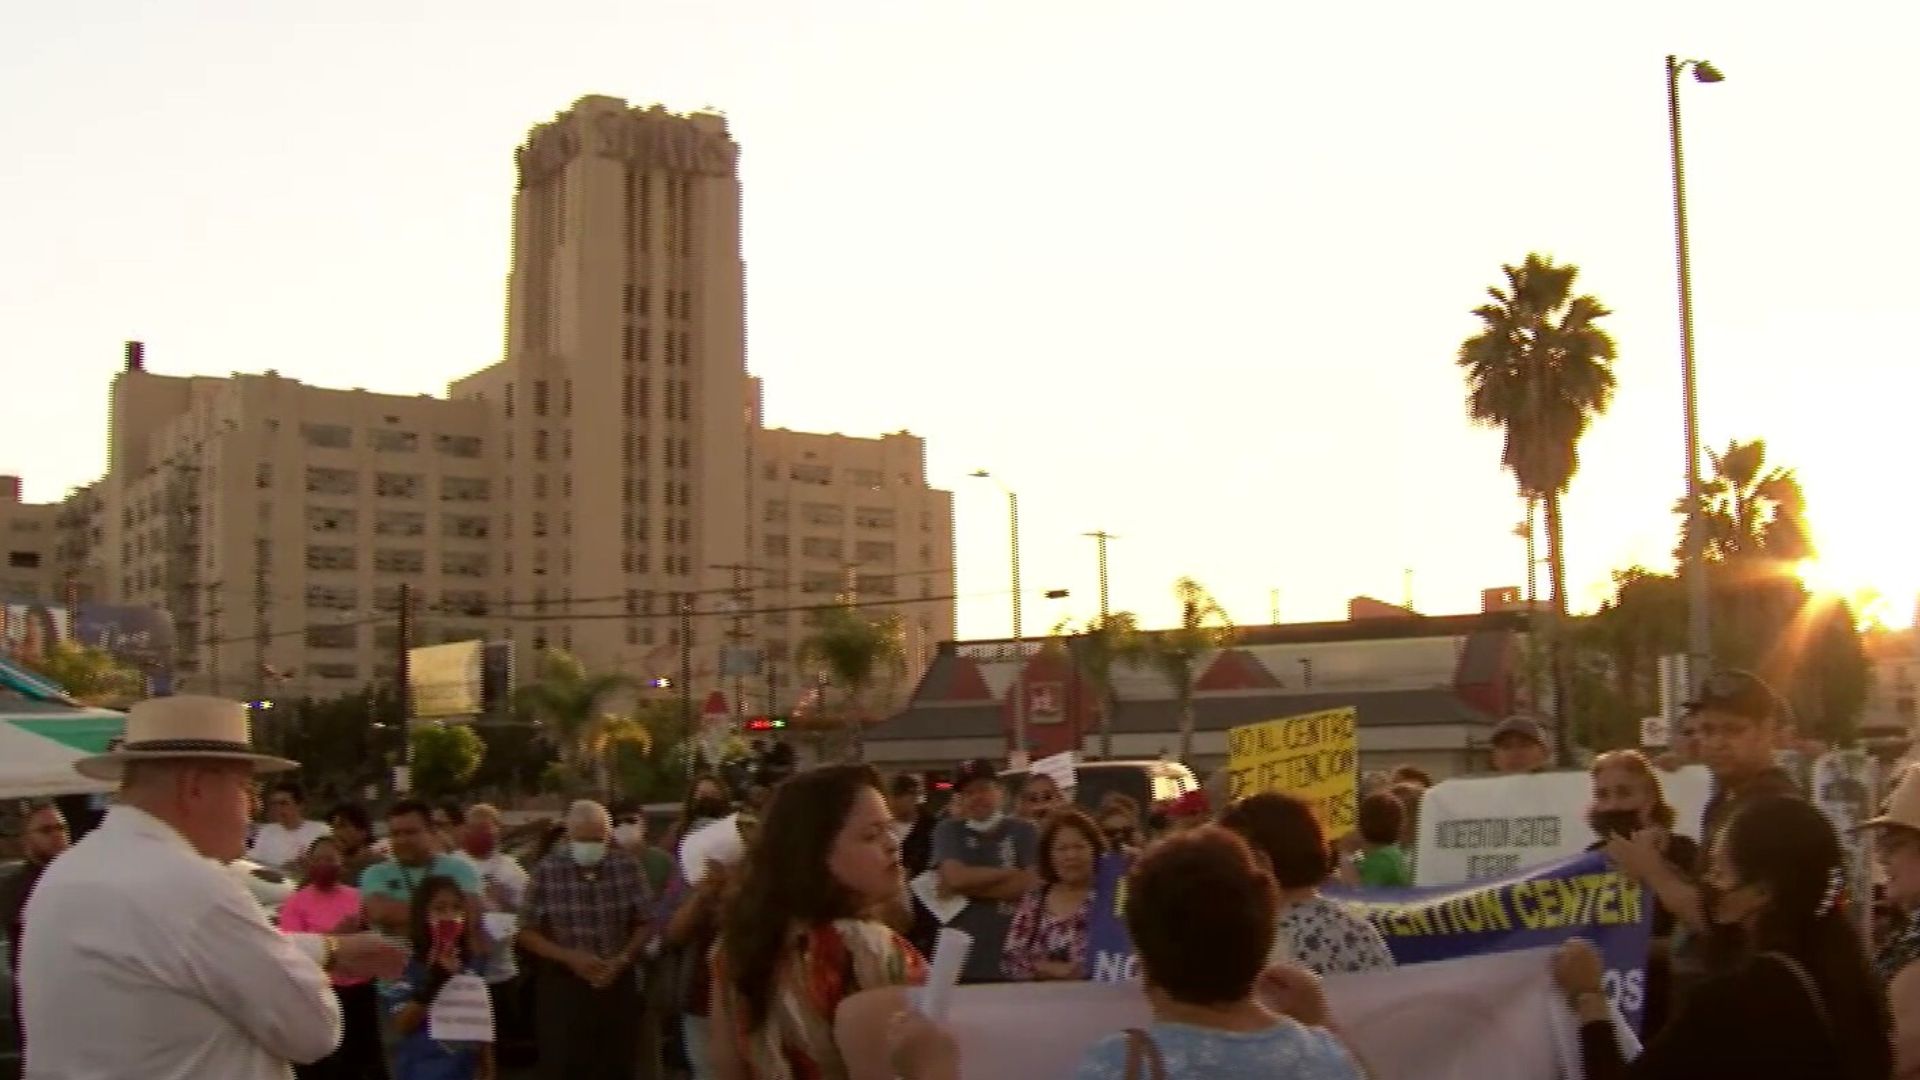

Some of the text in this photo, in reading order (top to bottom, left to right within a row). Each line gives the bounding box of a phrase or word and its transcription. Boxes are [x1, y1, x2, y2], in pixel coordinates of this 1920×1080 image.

[1230, 714, 1355, 758] NO AL CENTRO
[1259, 748, 1353, 790] DETENCION
[1451, 817, 1511, 849] DETENTION
[1513, 815, 1561, 848] CENTER
[1366, 871, 1642, 937] TENTION CENTER
[1601, 967, 1643, 1012] OS
